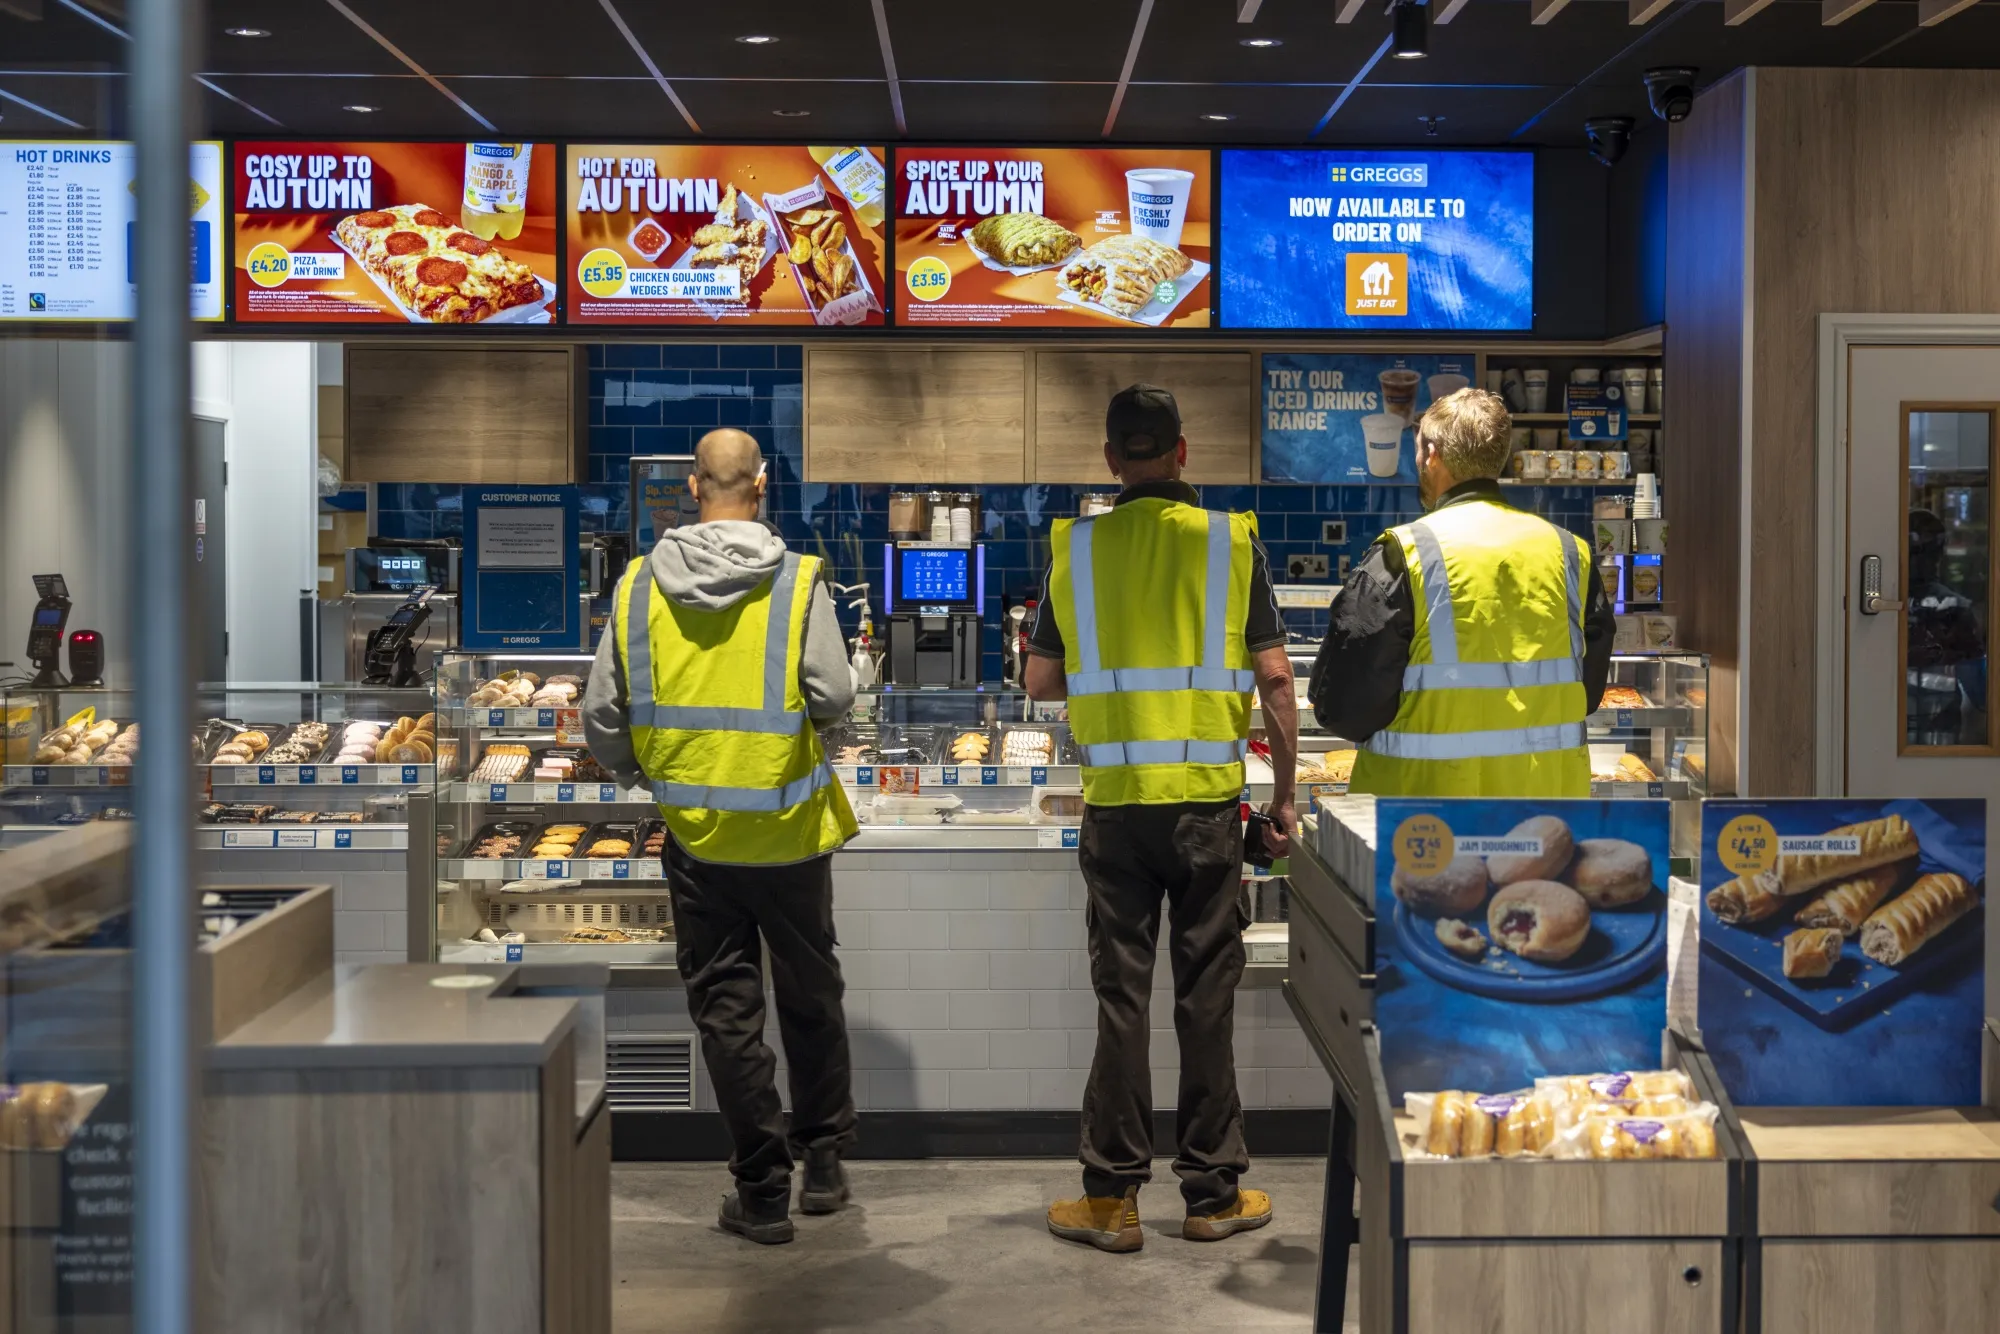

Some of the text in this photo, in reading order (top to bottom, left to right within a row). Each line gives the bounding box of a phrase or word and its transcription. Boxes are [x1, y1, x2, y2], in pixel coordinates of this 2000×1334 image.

[16, 150, 111, 163] HOT DRINKS
[481, 147, 512, 155] GREGGS
[840, 151, 860, 167] GREGGS
[246, 155, 372, 179] COSY UP TO
[471, 165, 514, 179] MANGO &
[578, 157, 656, 178] HOT FOR
[906, 160, 1043, 182] SPICE UP YOUR
[1350, 167, 1423, 182] GREGGS
[469, 175, 517, 190] PINEAPPLE
[843, 166, 865, 184] MANGO
[846, 166, 879, 191] PINEAPPLE
[246, 178, 372, 209] AUTUMN
[577, 178, 719, 213] AUTUMN
[905, 181, 1044, 215] AUTUMN
[1134, 206, 1171, 218] FRESHLY
[1290, 198, 1465, 218] NOW AVAILABLE TO
[1134, 216, 1169, 228] GROUND
[1332, 223, 1422, 242] ORDER ON
[251, 259, 288, 273] £4.20
[294, 267, 312, 275] ANY
[584, 266, 622, 282] £5.95
[630, 273, 670, 282] CHICKEN
[673, 273, 715, 282] GOUJONS
[912, 273, 946, 287] £3.95
[630, 286, 668, 295] WEDGES
[683, 286, 701, 295] ANY
[1356, 300, 1397, 308] JUST EAT
[1268, 370, 1343, 389] TRY OUR
[1268, 391, 1377, 410] ICED DRINKS
[1268, 411, 1327, 430] RANGE
[481, 493, 561, 502] CUSTOMER NOTICE
[645, 484, 660, 496] Sip.
[1459, 842, 1539, 852] JAM DOUGHNUTS
[1782, 840, 1856, 851] SAUSAGE ROLLS
